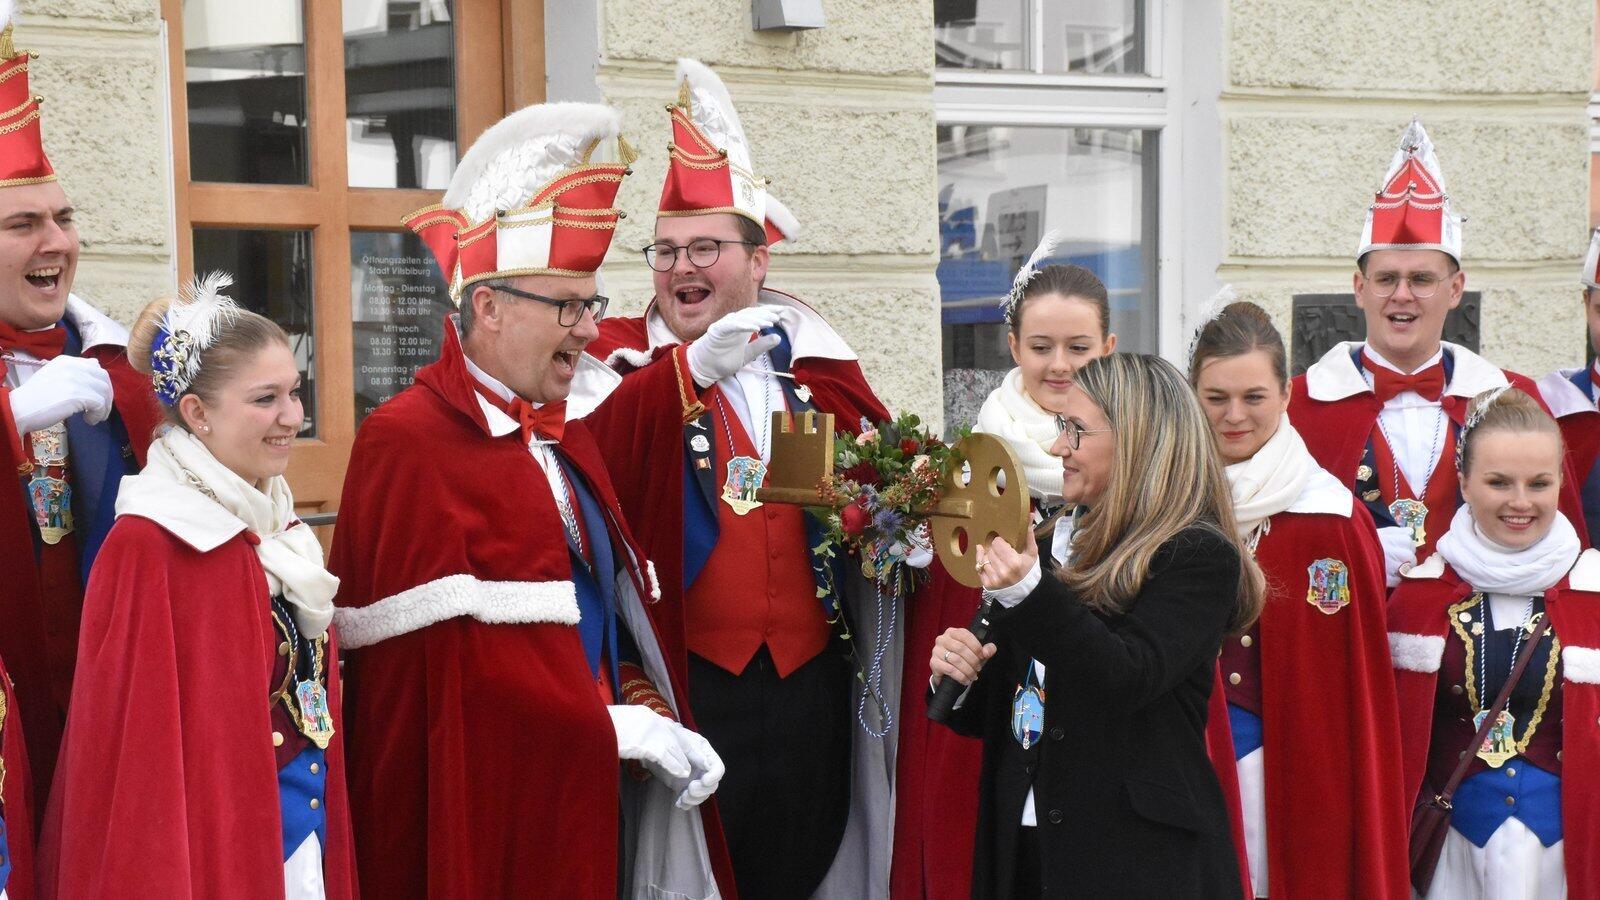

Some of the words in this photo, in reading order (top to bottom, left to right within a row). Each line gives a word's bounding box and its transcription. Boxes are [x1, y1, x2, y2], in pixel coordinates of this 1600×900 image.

[368, 266, 390, 275] Stadt
[391, 266, 431, 277] Vilsbiburg
[364, 284, 395, 294] Montag
[401, 284, 436, 294] Dienstag
[418, 307, 431, 315] Uhr
[370, 338, 392, 346] 08.00
[398, 348, 416, 356] 17.30
[418, 348, 430, 356] Uhr
[361, 365, 407, 374] Donnerstag
